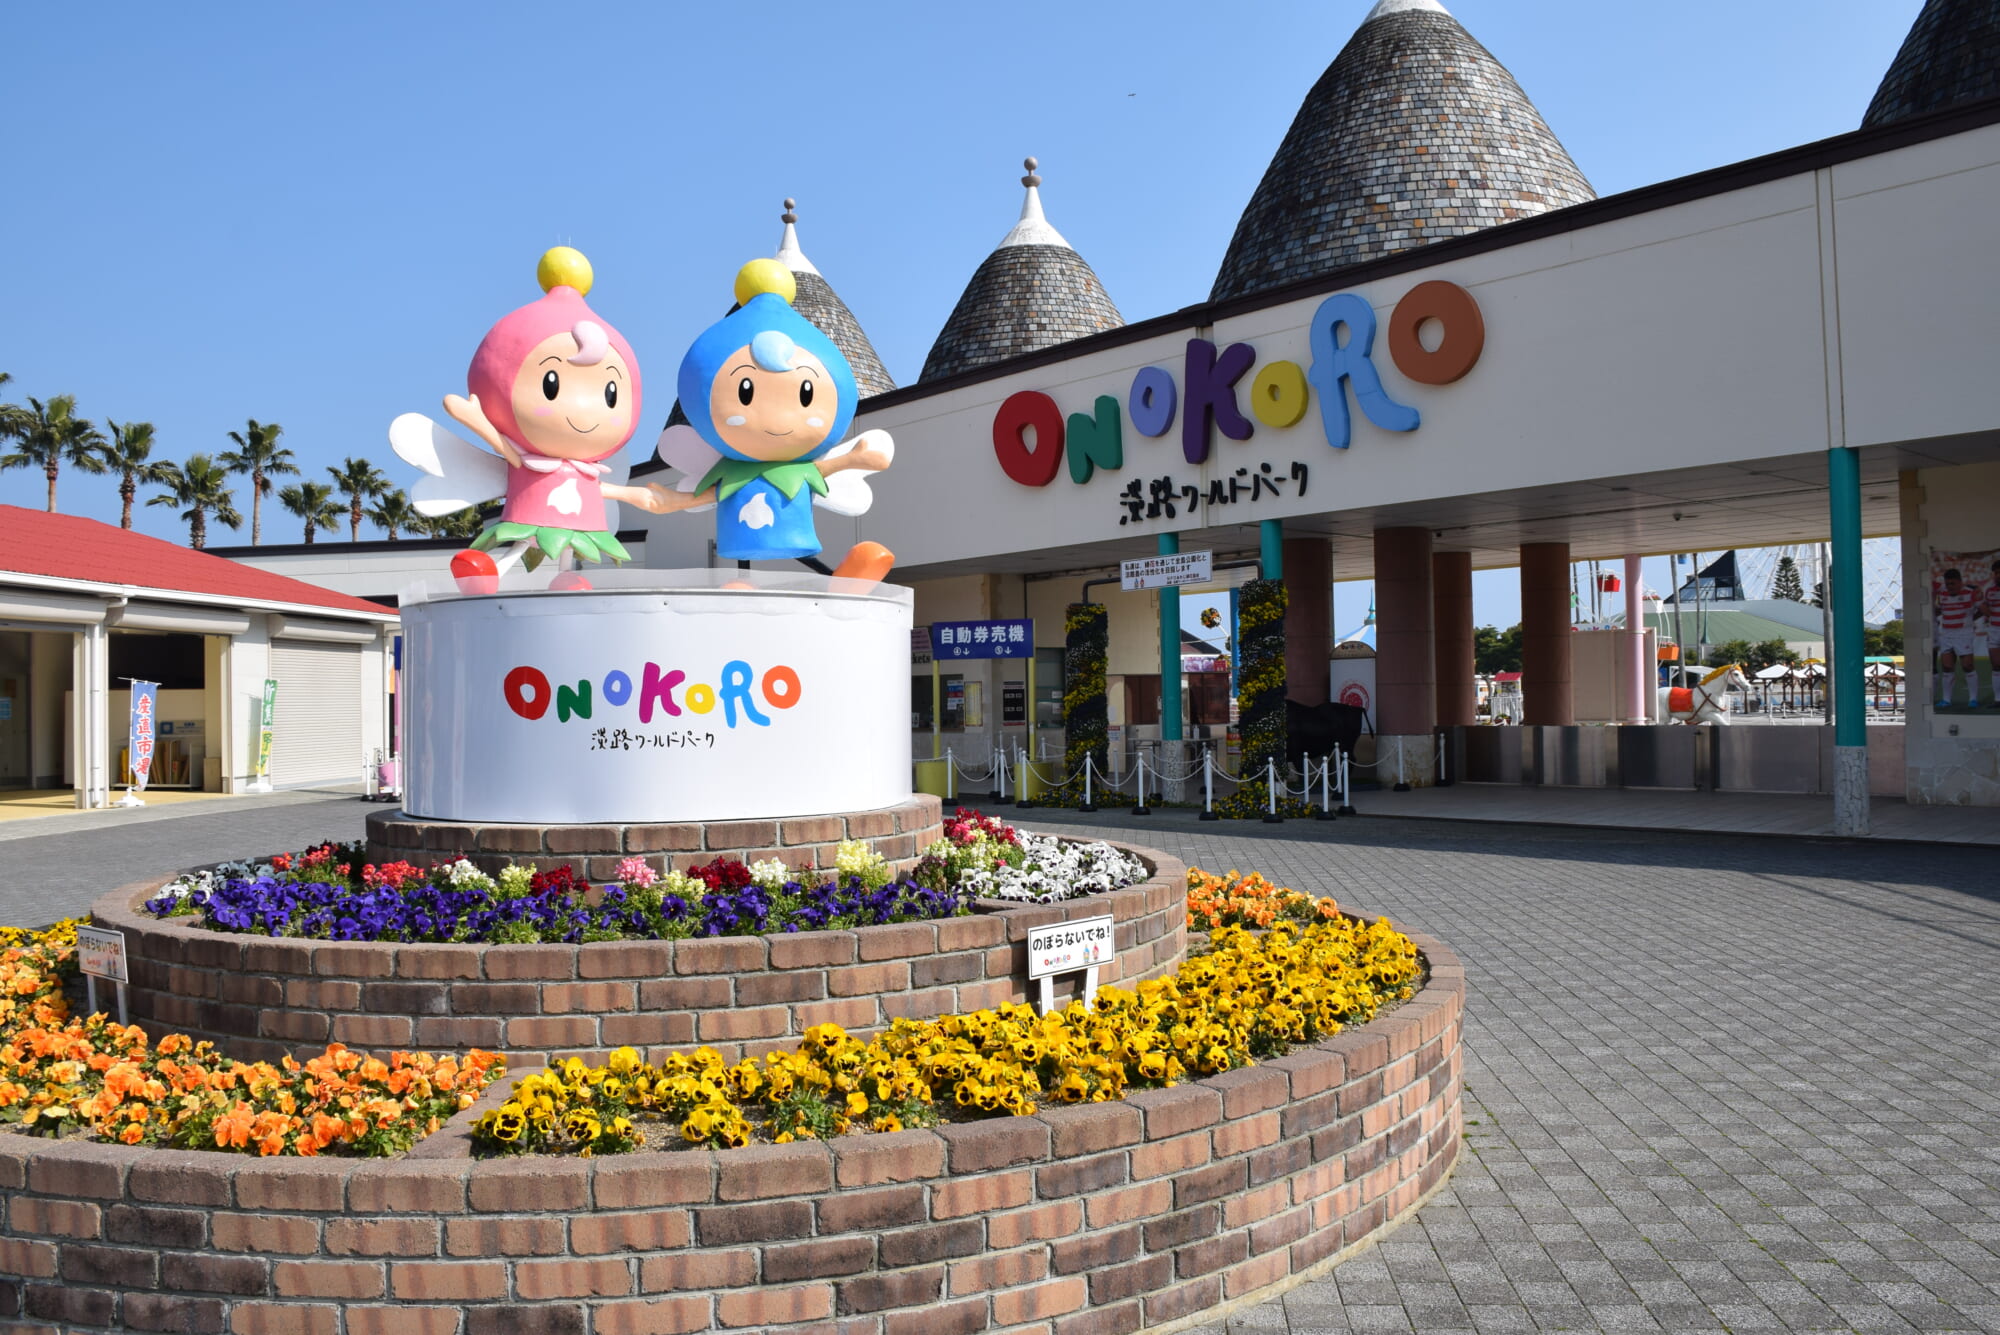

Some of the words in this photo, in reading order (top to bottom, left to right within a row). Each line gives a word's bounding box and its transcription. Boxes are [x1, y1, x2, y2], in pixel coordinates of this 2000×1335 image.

[993, 280, 1484, 486] ONOKORO
[1119, 461, 1308, 526] 淡路ワールドパーク
[941, 624, 1025, 645] 自動券売機
[503, 660, 802, 728] ONOKORO
[135, 693, 153, 775] 産直市場
[590, 726, 715, 751] 淡路ワールドパーク
